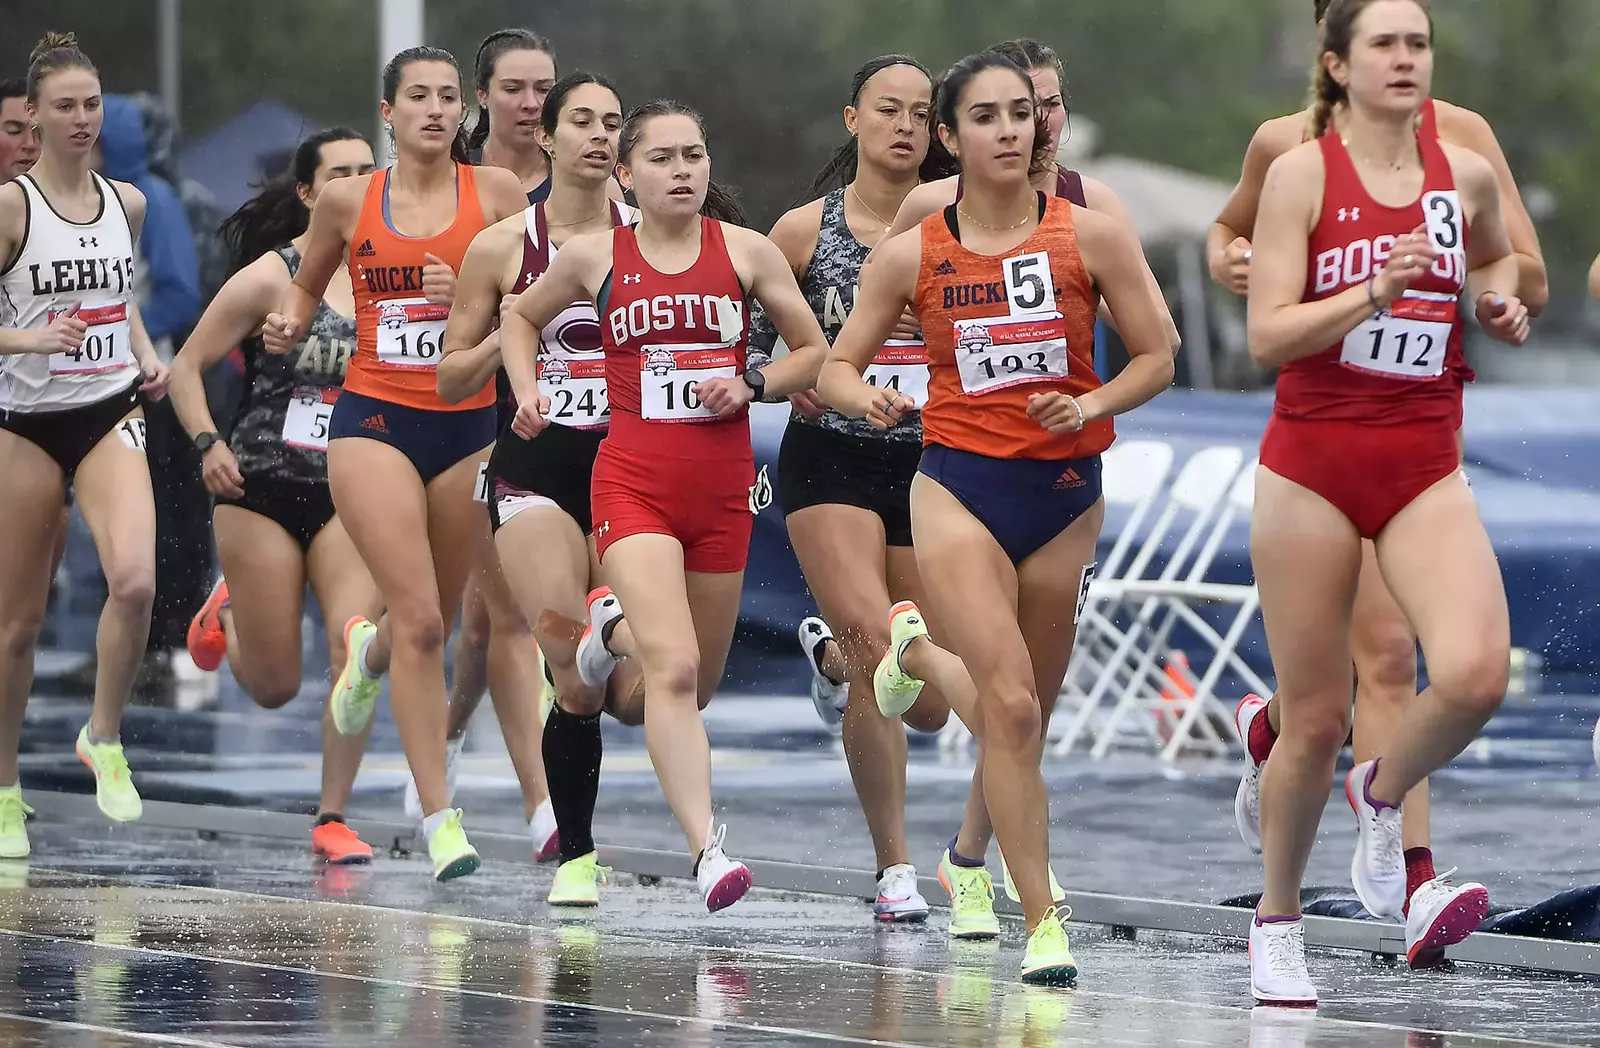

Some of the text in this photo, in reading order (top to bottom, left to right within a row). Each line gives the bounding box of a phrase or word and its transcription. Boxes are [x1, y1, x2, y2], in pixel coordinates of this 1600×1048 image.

[1430, 196, 1457, 248] 3
[29, 258, 110, 295] LEHI
[365, 266, 423, 292] BUCK
[1012, 258, 1045, 309] 5
[943, 279, 1008, 309] BUCK
[609, 294, 742, 346] BOSTO
[1370, 328, 1433, 366] 112
[978, 352, 1048, 379] 193
[661, 380, 701, 410] 10
[310, 413, 329, 438] 5
[1053, 479, 1087, 490] adidas
